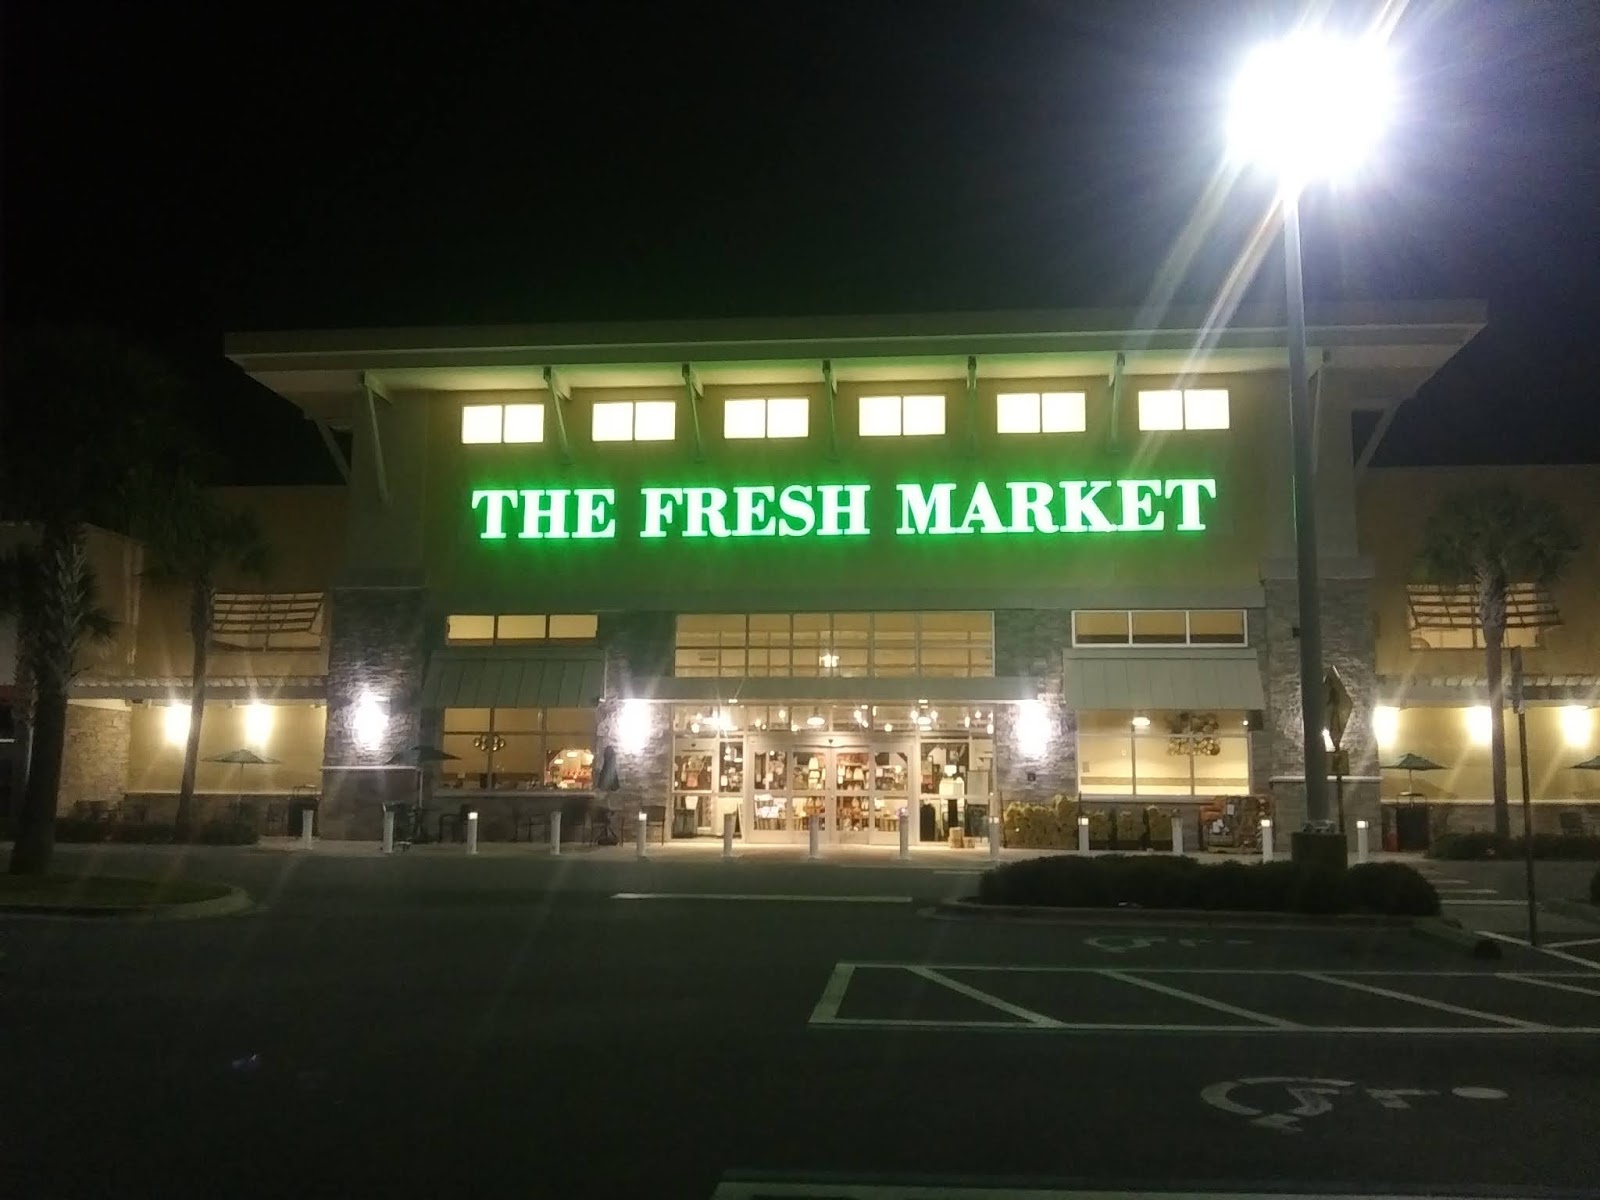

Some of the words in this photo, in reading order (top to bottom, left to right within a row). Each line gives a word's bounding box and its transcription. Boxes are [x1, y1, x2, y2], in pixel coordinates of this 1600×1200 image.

[471, 488, 616, 539] THE
[640, 485, 870, 538] FRESH
[895, 477, 1218, 535] MARKET
